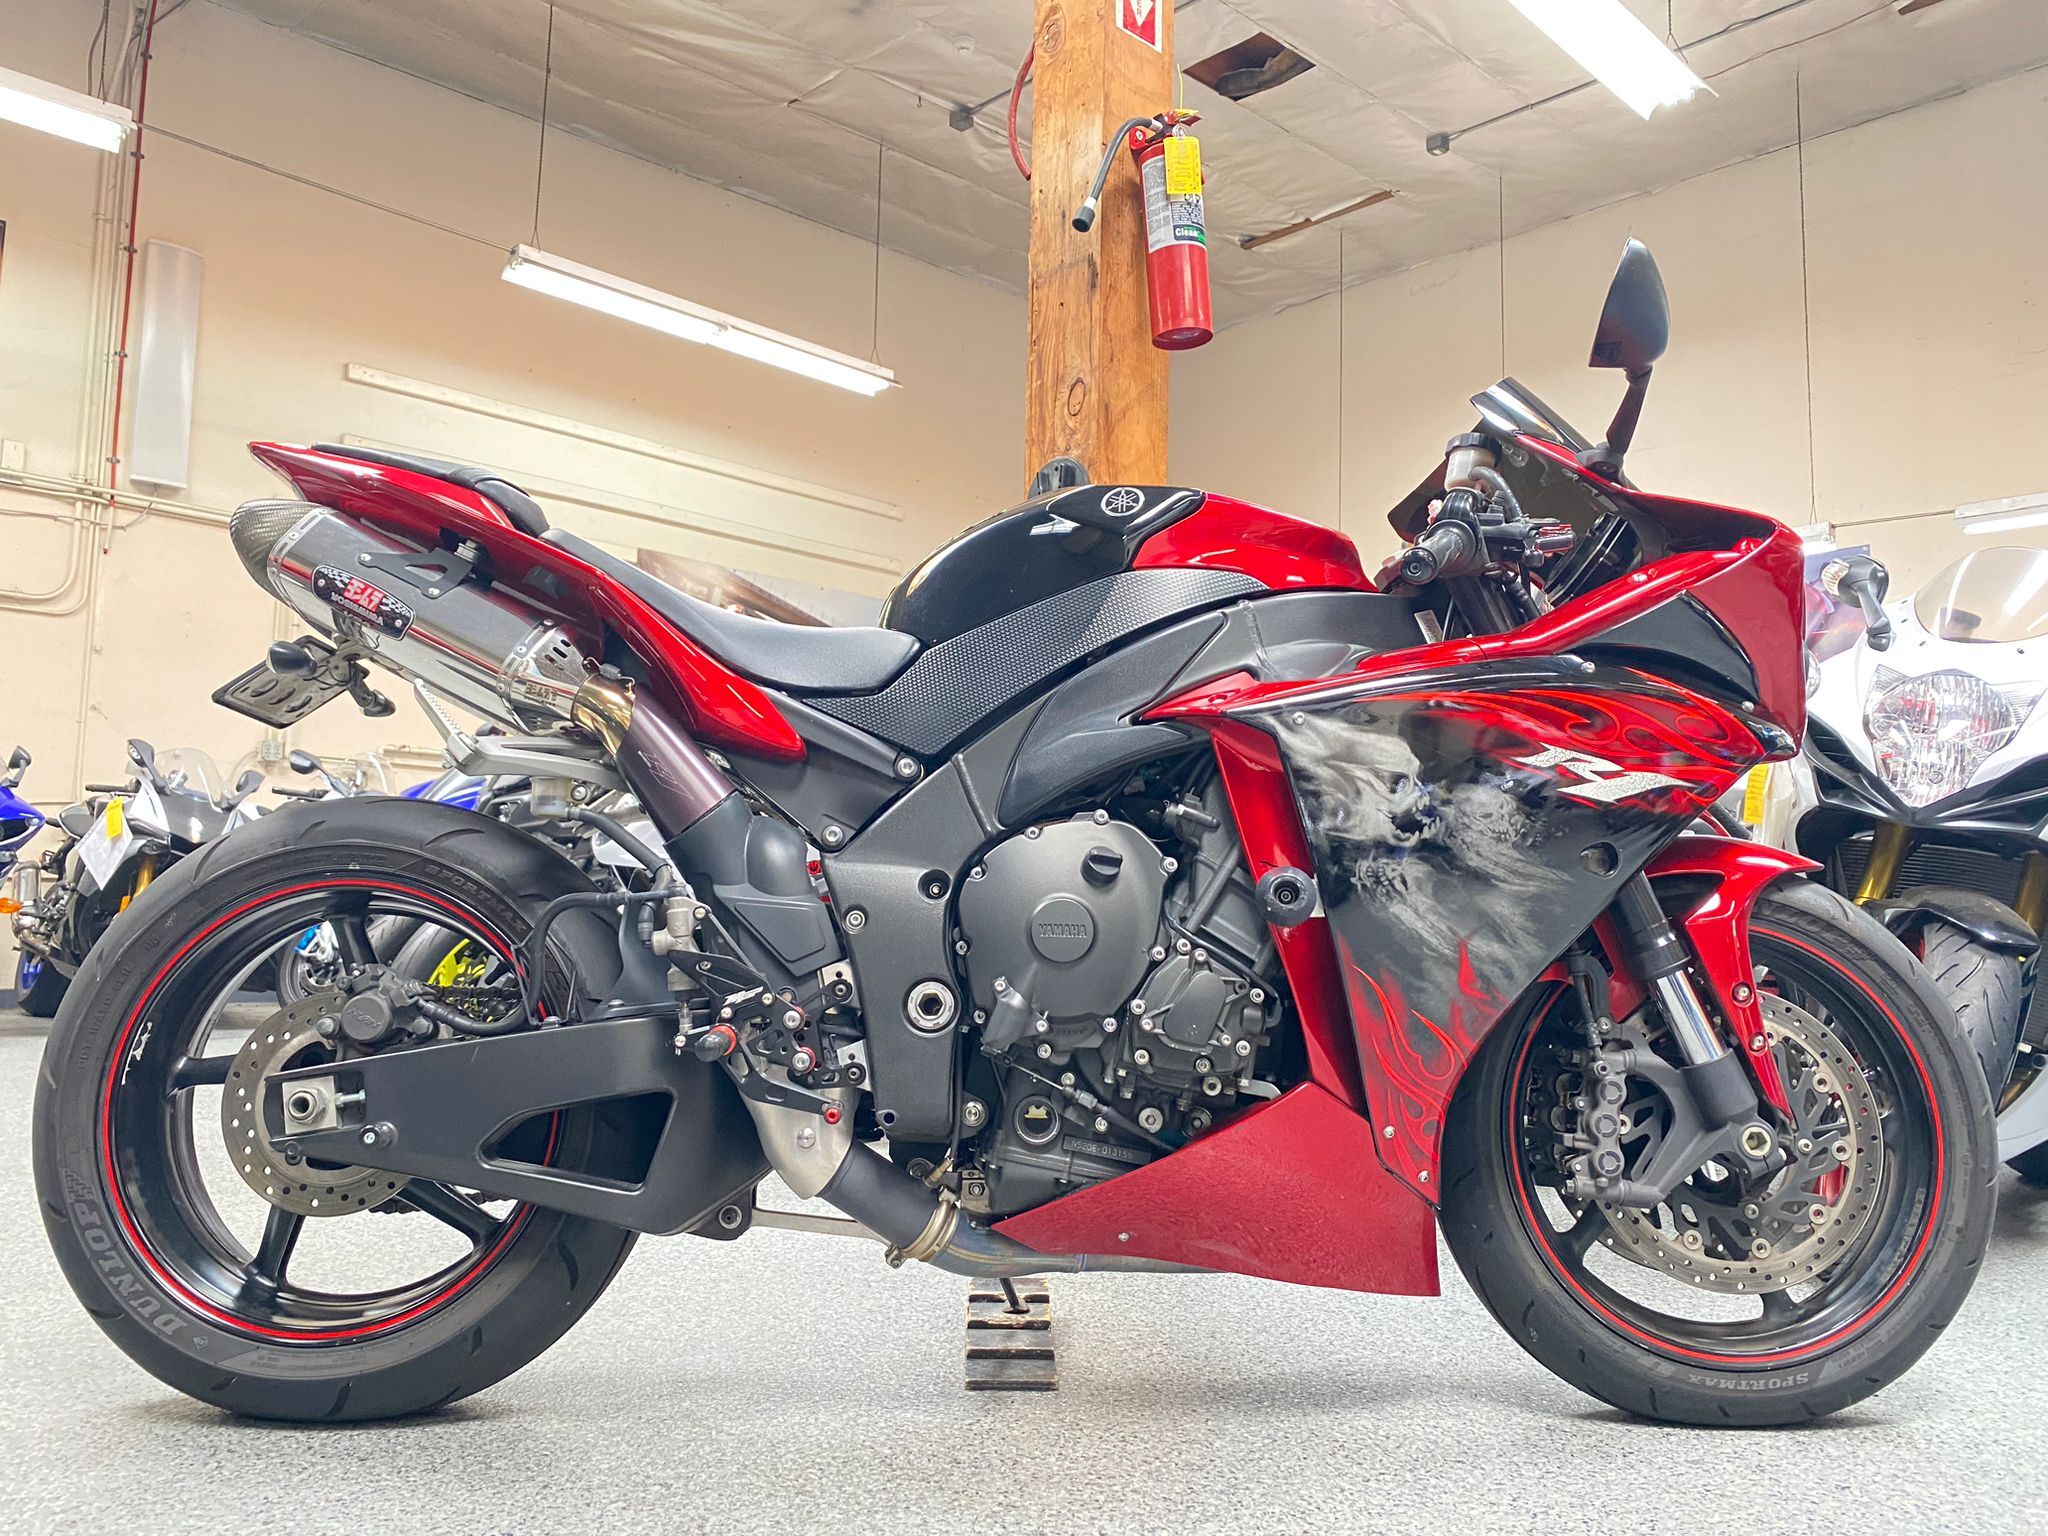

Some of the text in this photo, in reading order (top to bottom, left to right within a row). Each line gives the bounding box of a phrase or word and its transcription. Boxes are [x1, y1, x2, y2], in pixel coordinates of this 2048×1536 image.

[425, 864, 527, 933] SPORTMAX
[1038, 923, 1088, 938] YAMAHA
[74, 1199, 188, 1338] DUNLOP
[1685, 1371, 1810, 1391] SPORTMAX
